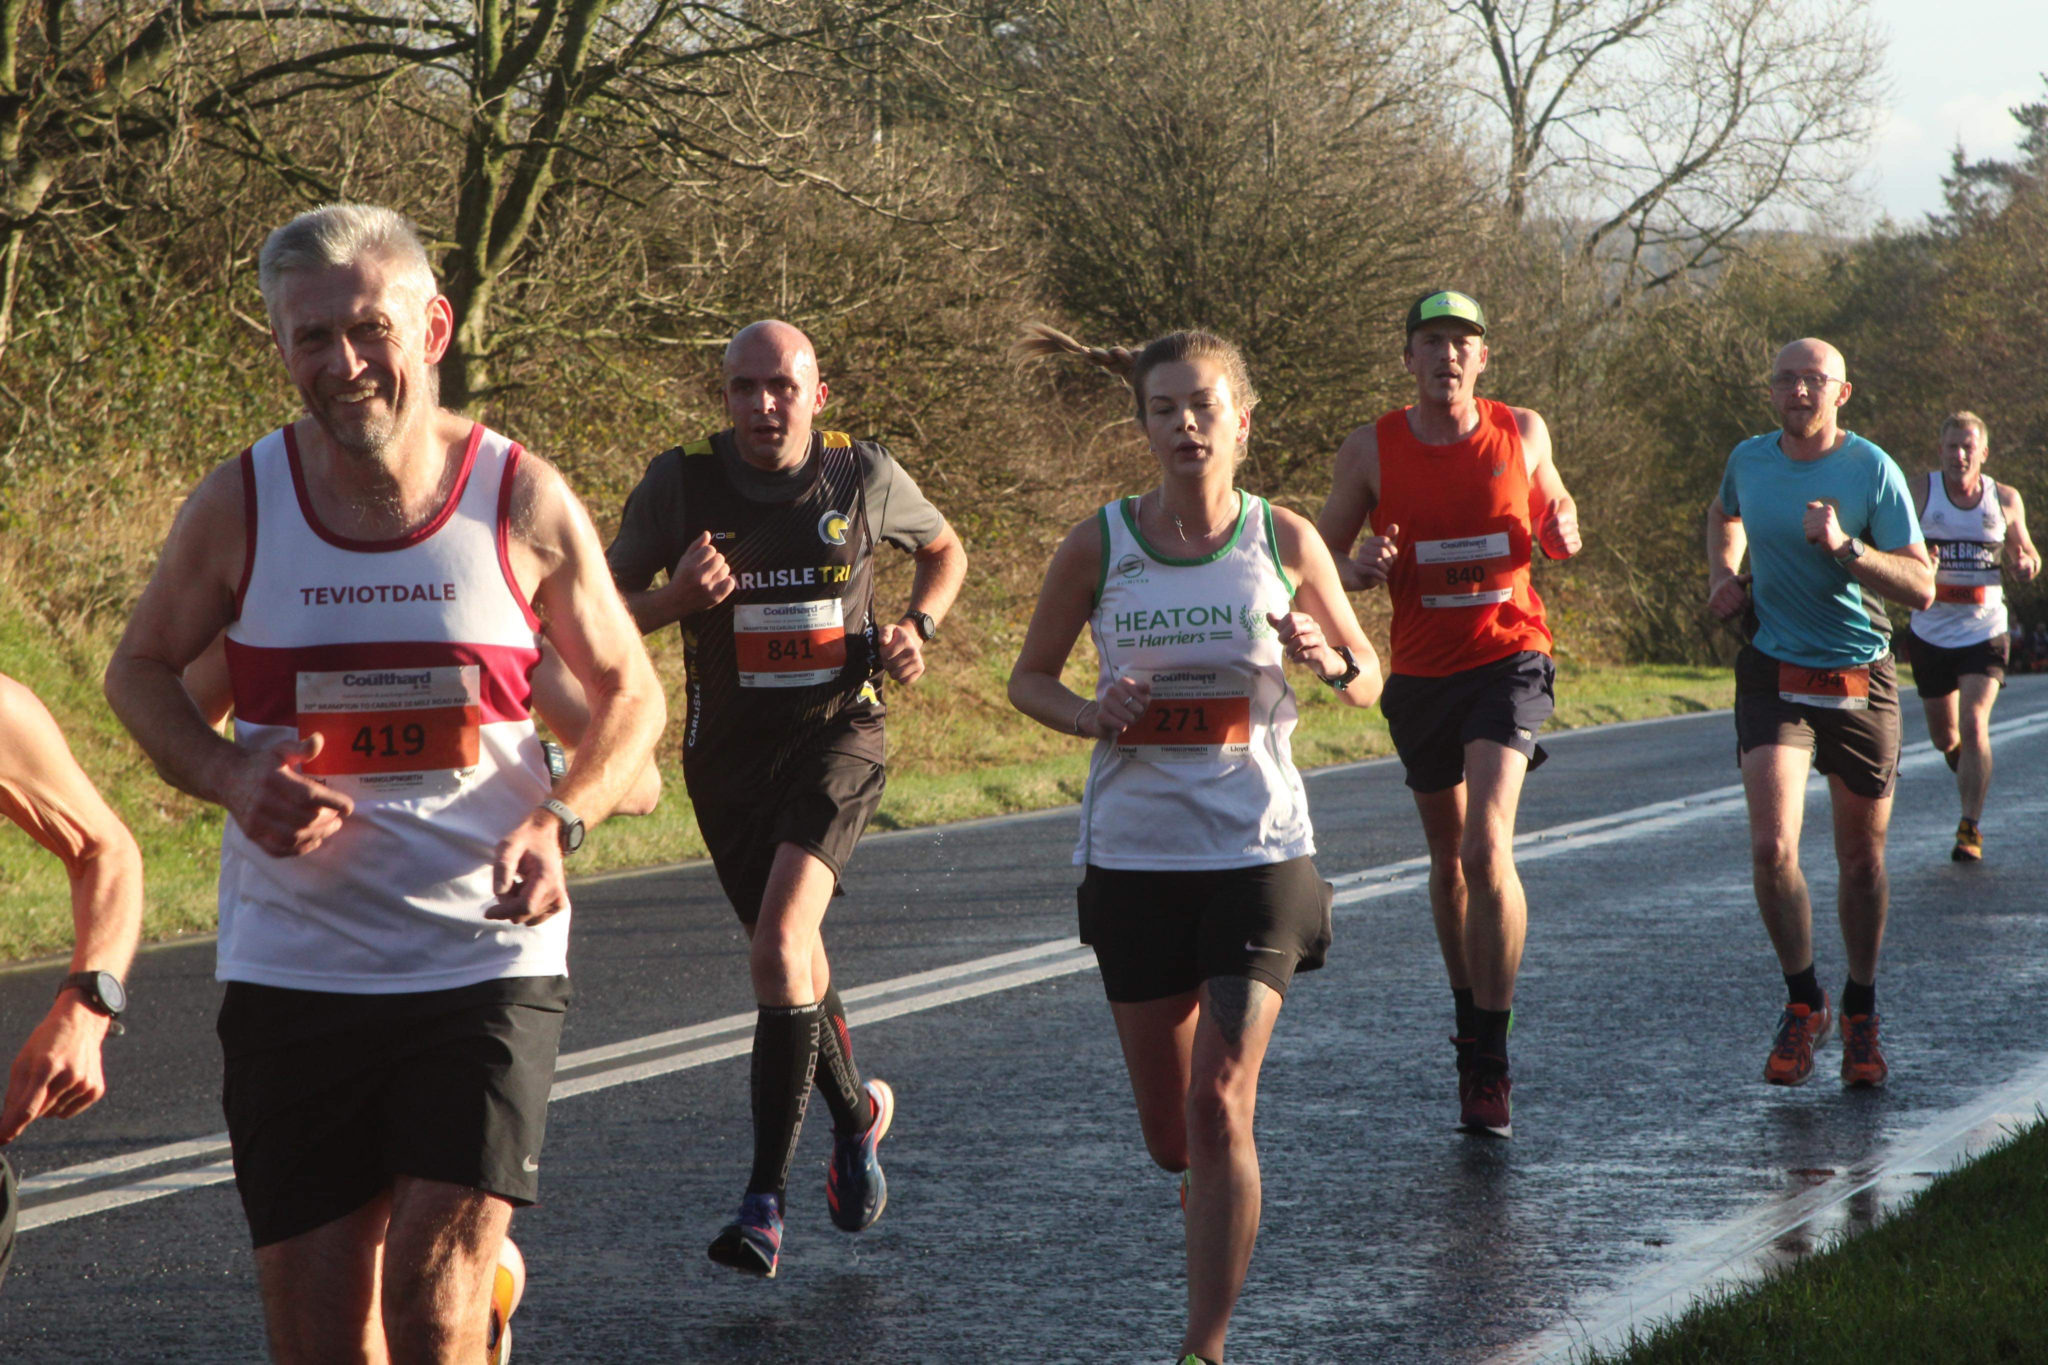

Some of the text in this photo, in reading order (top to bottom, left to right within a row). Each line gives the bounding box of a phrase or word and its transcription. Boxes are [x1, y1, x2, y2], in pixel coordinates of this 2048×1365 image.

[732, 564, 851, 590] ARLISLE TRI
[1446, 565, 1485, 585] 840
[301, 583, 456, 606] TEVIOTDALE
[763, 604, 818, 616] Coulthard
[1115, 605, 1232, 632] HEATON
[1139, 630, 1205, 648] Harriers
[768, 639, 814, 661] 841
[342, 671, 431, 687] Coulthard
[1152, 672, 1216, 683] Coulthard
[1805, 671, 1841, 688] 794
[1155, 706, 1208, 731] 271
[353, 723, 425, 757] 419
[1230, 745, 1249, 753] Lloyd
[778, 1052, 818, 1190] compression
